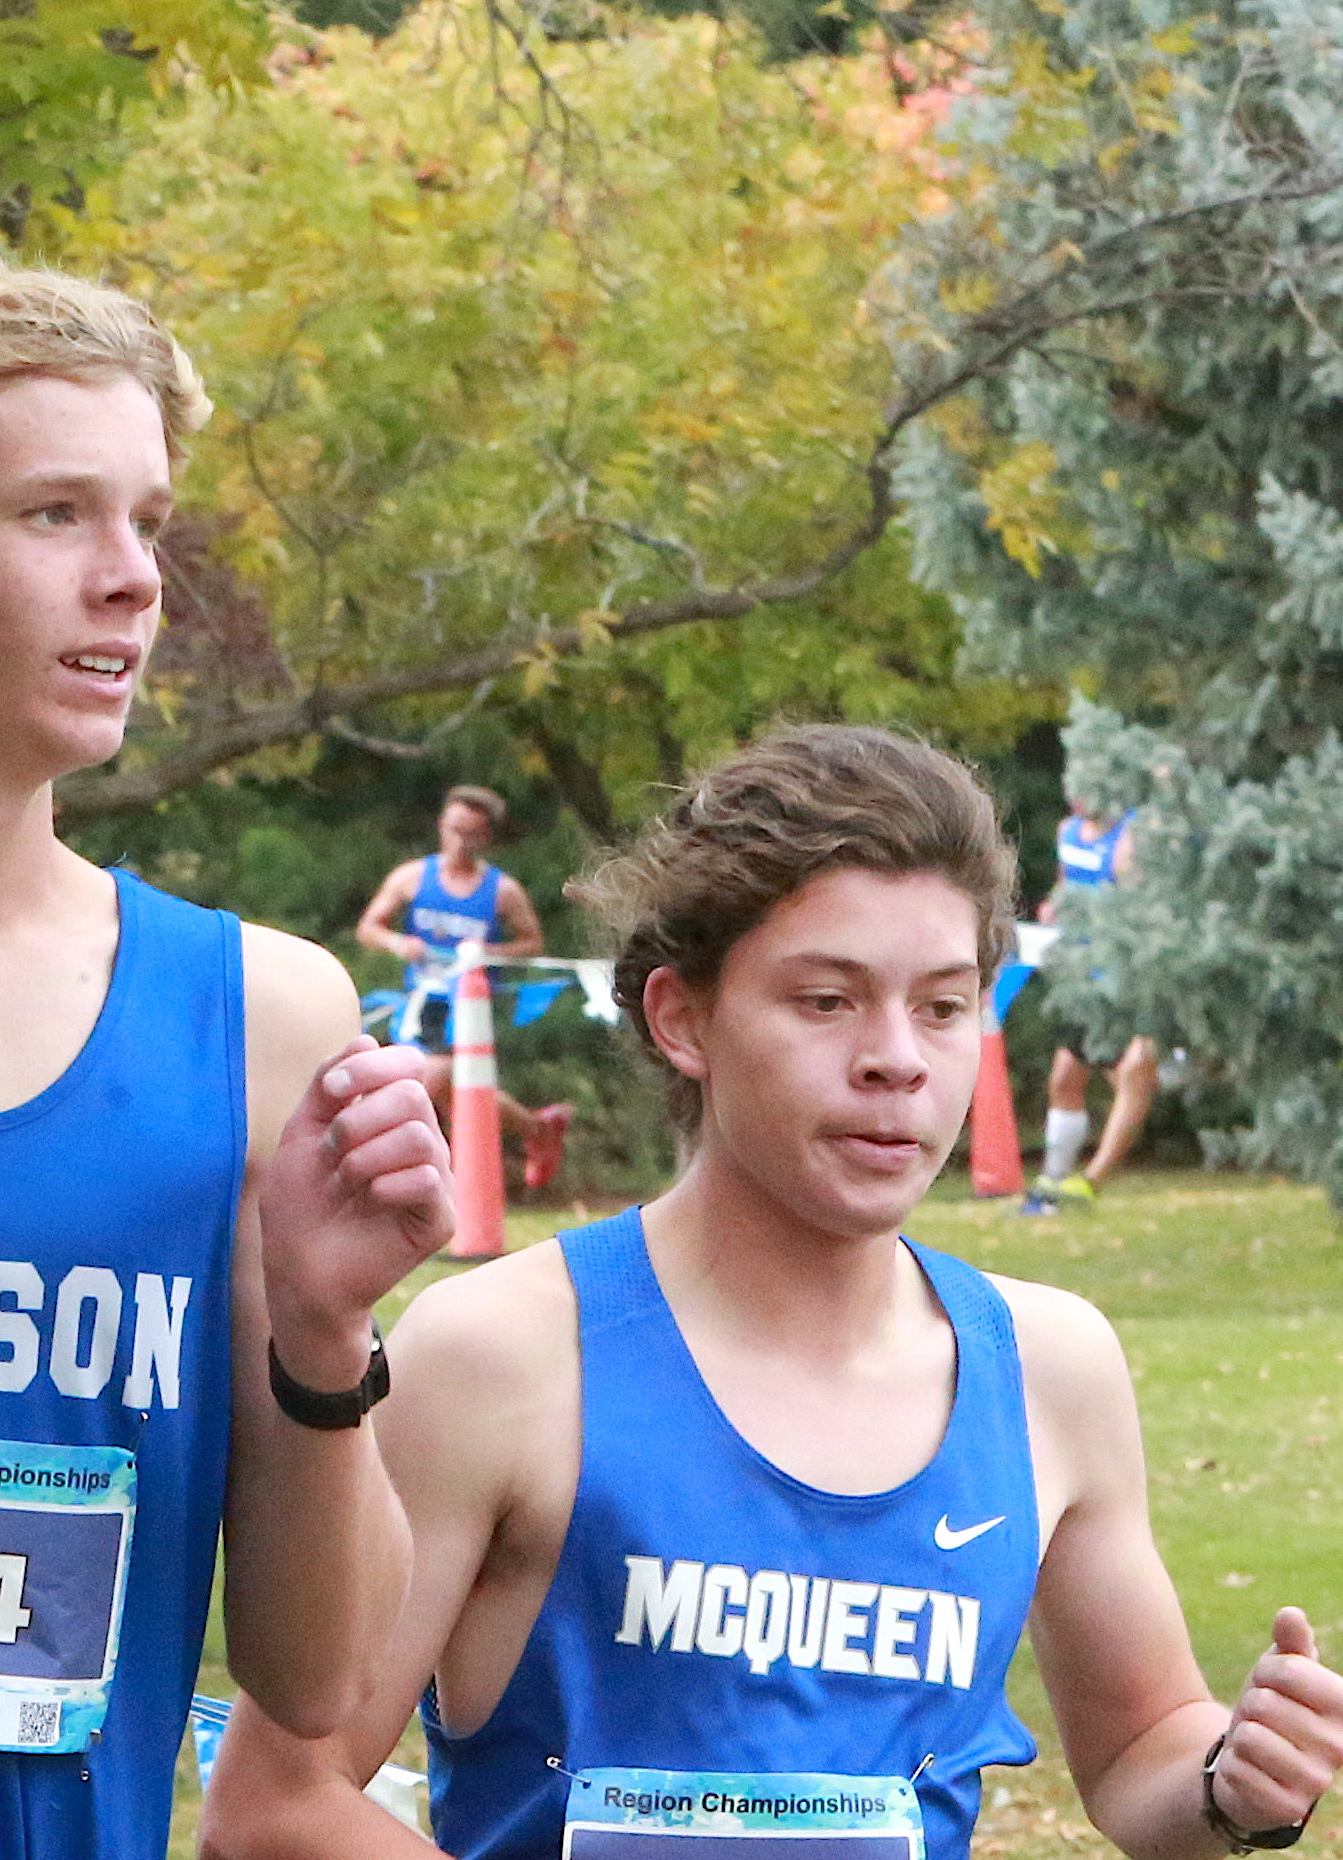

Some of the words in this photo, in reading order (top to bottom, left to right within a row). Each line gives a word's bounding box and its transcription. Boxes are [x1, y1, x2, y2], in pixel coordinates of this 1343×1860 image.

[614, 1554, 981, 1691] MCQUEEN
[603, 1786, 693, 1815] Region
[701, 1791, 887, 1819] Championships
